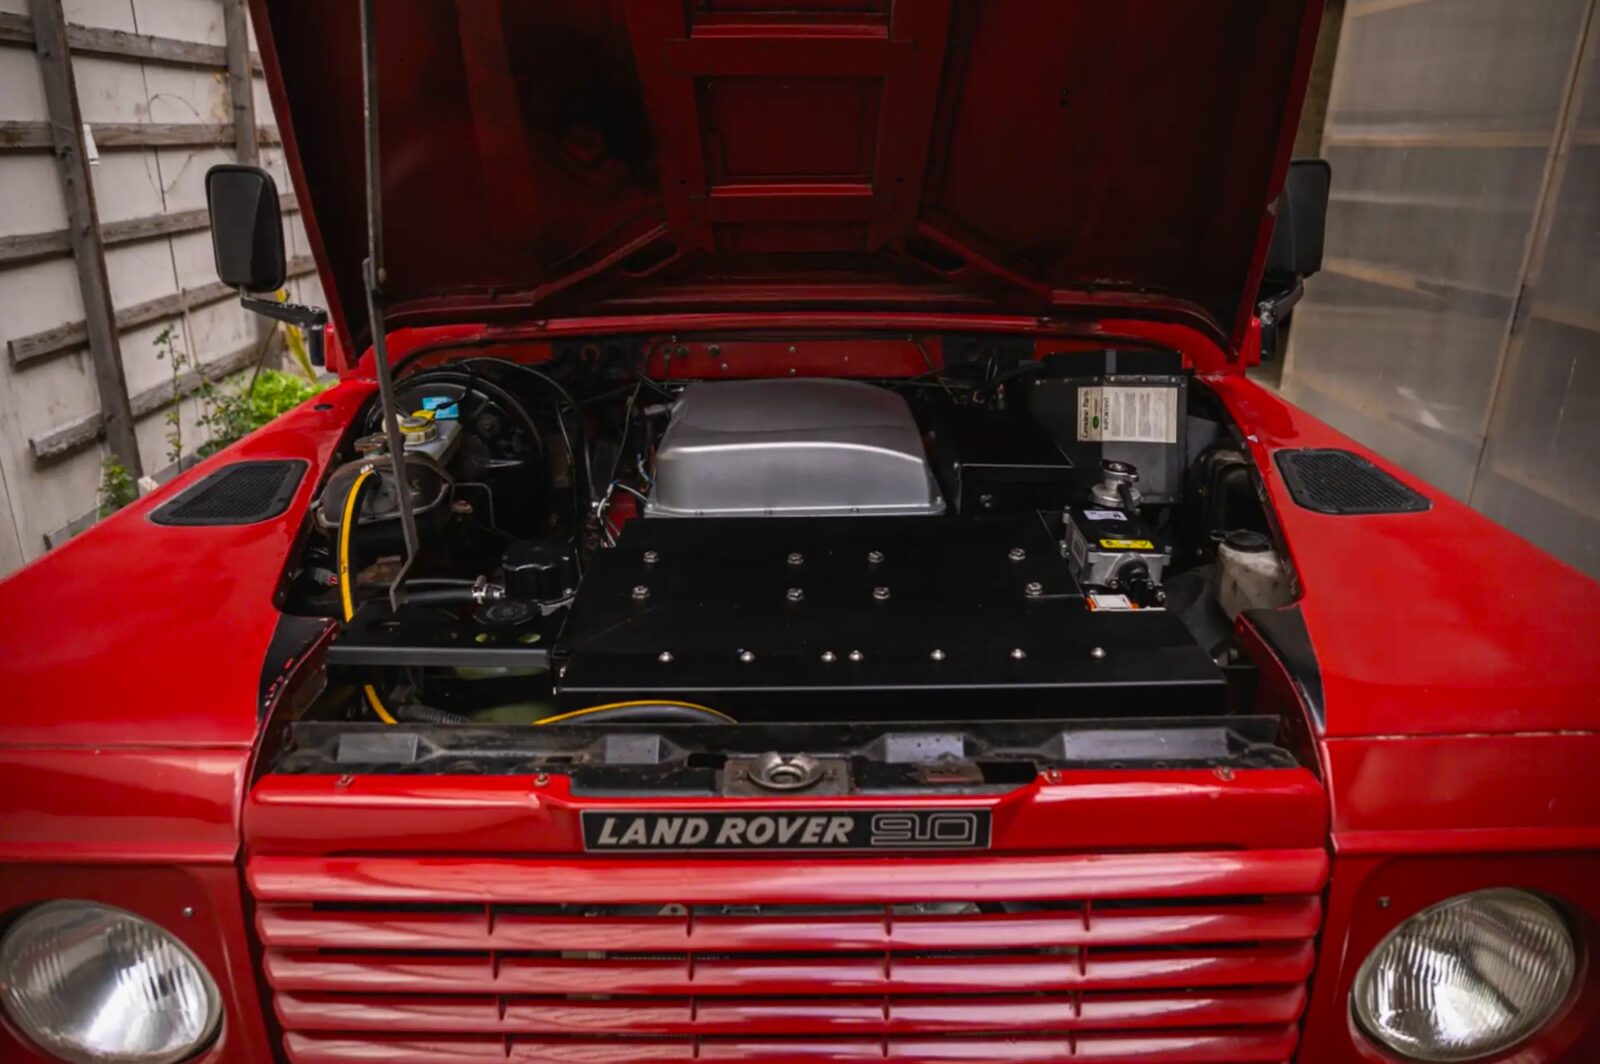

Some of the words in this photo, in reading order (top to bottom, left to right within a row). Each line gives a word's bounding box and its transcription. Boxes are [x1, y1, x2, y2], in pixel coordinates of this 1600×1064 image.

[598, 817, 709, 846] LAND
[715, 816, 855, 845] ROVER
[871, 813, 977, 846] 90
